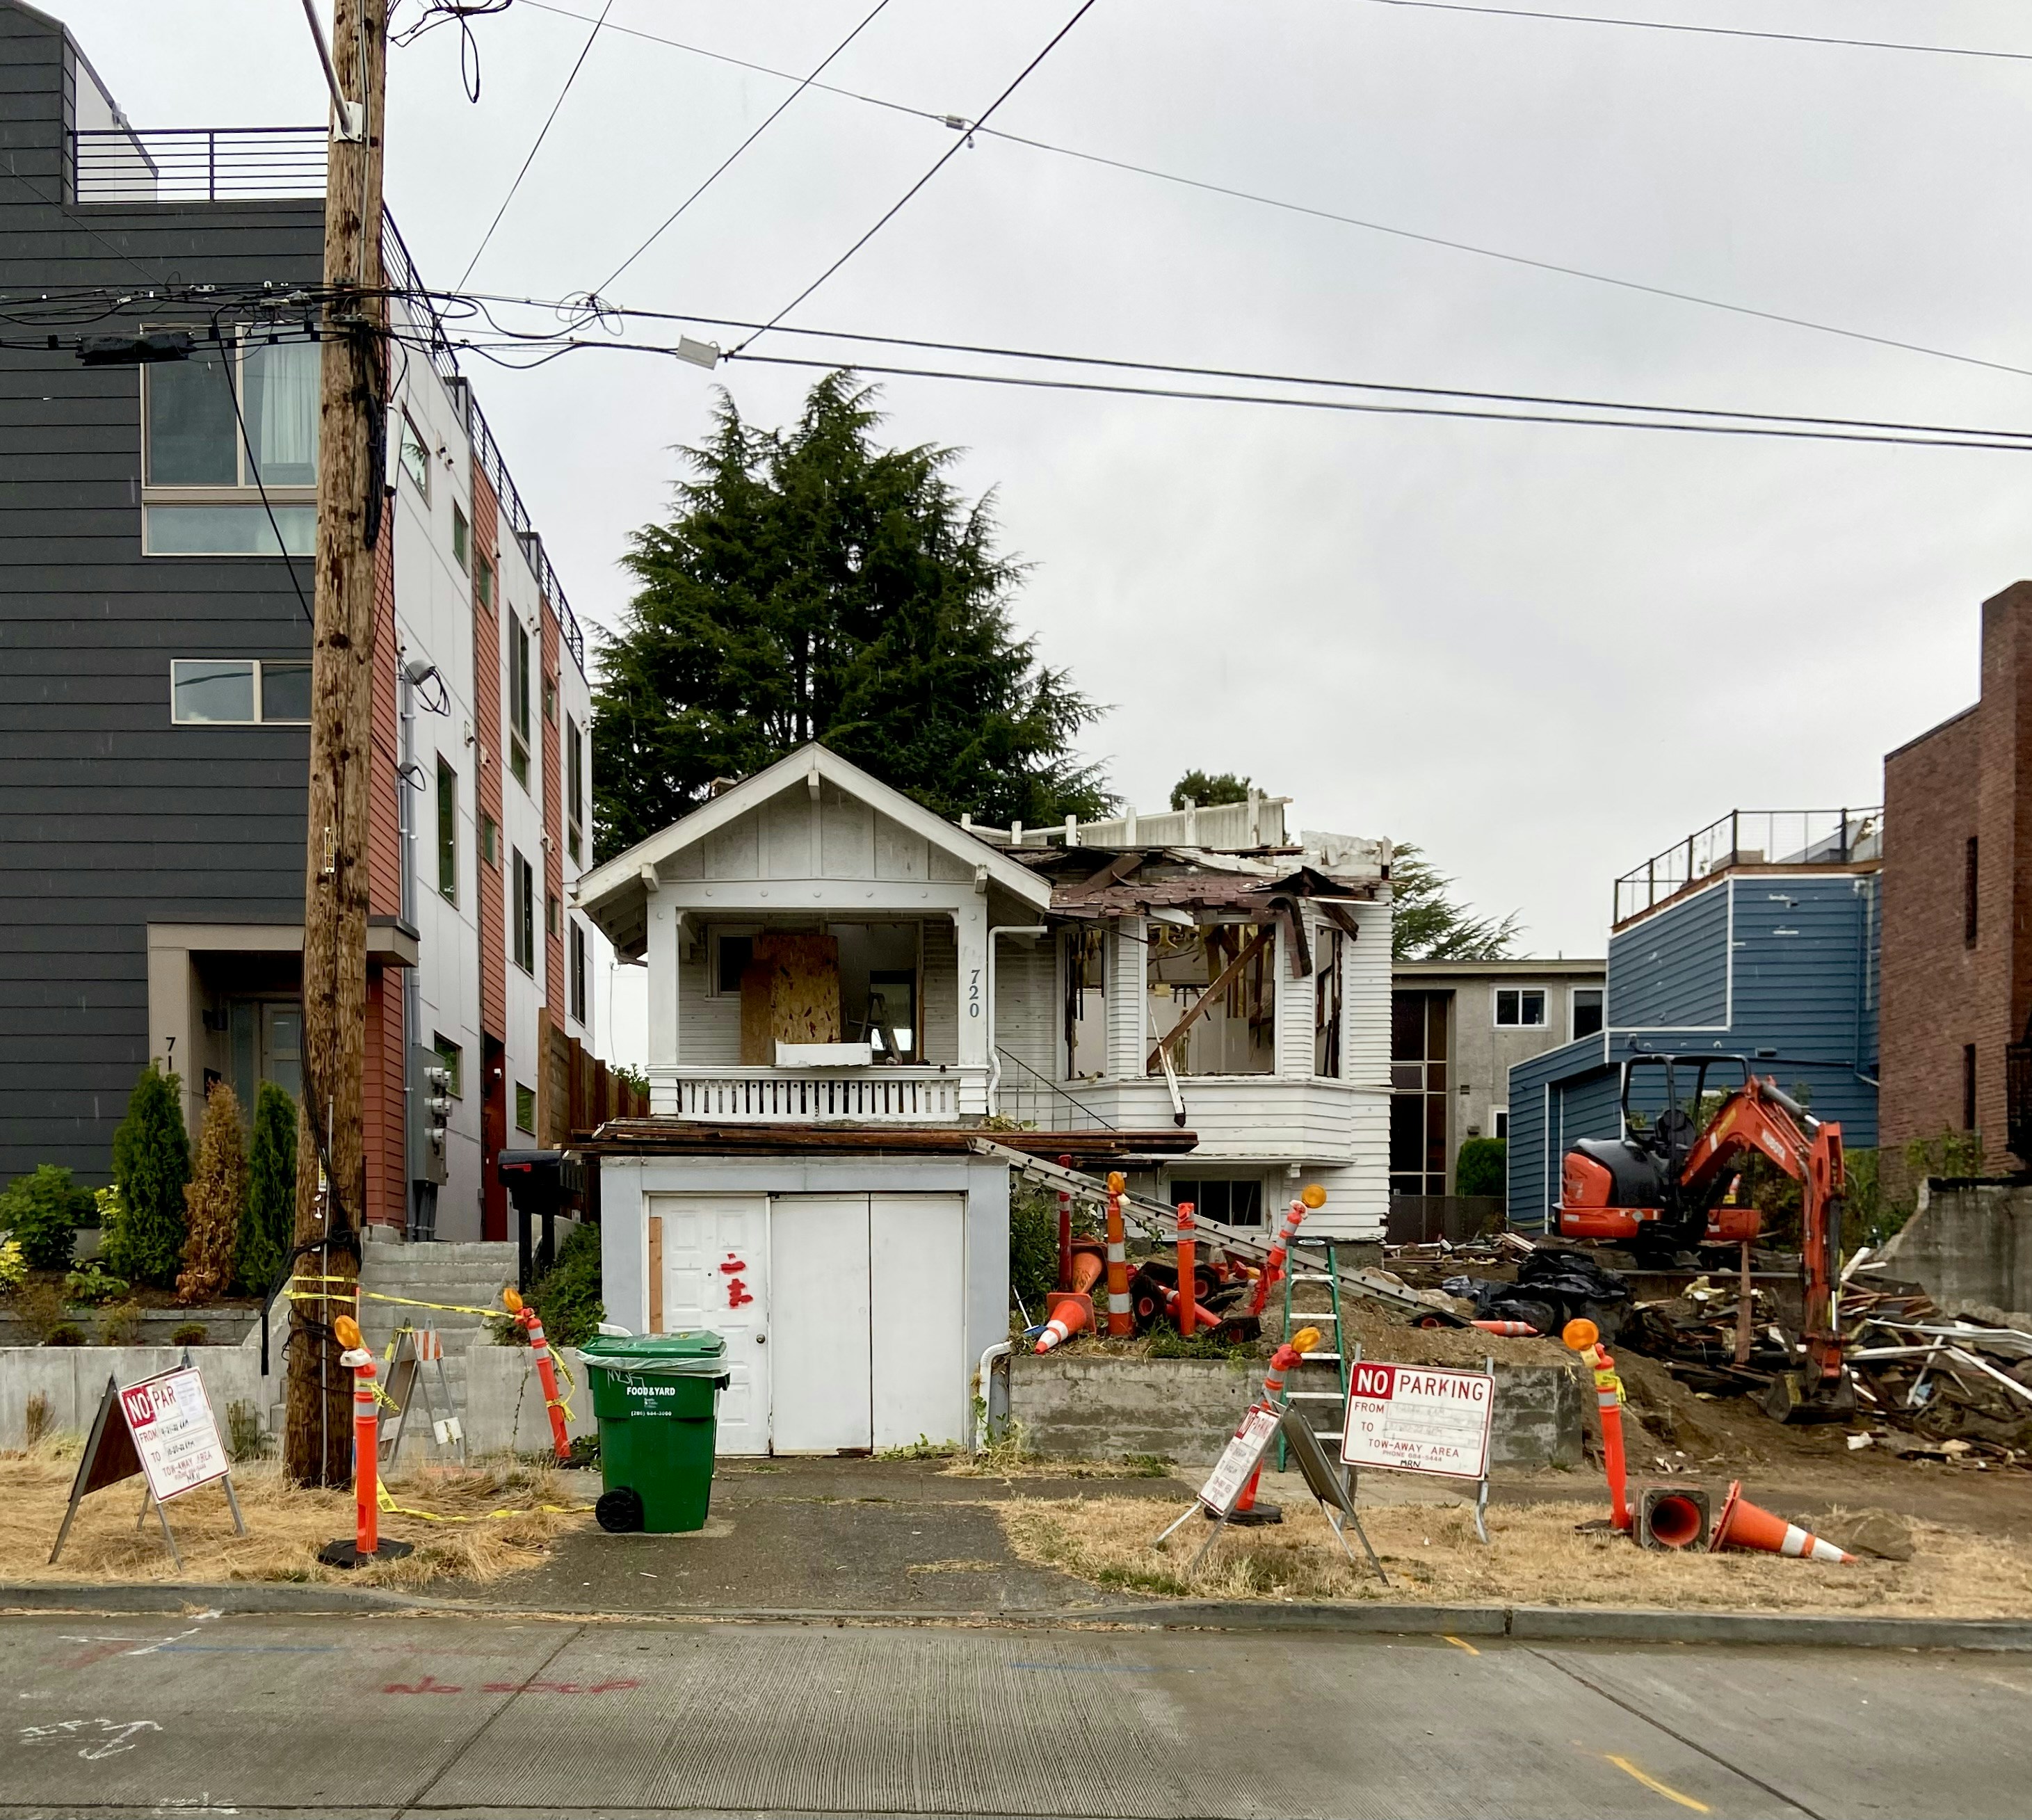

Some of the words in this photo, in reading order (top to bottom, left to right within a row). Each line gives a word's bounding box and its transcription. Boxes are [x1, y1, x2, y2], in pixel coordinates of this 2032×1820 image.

[969, 969, 981, 1017] 720
[627, 1386, 676, 1396] FOOD&YARD
[1357, 1368, 1389, 1395] NO
[1399, 1374, 1484, 1401] PARKING
[127, 1392, 151, 1423] NO
[1354, 1401, 1385, 1414] FROM
[1361, 1422, 1374, 1432] TO
[139, 1428, 159, 1444] FROM
[1369, 1438, 1423, 1453] TOW-AWAY
[1430, 1447, 1459, 1458] AREA
[1382, 1449, 1405, 1458] PHONE
[150, 1451, 161, 1463] TO
[1400, 1459, 1421, 1468] MRN
